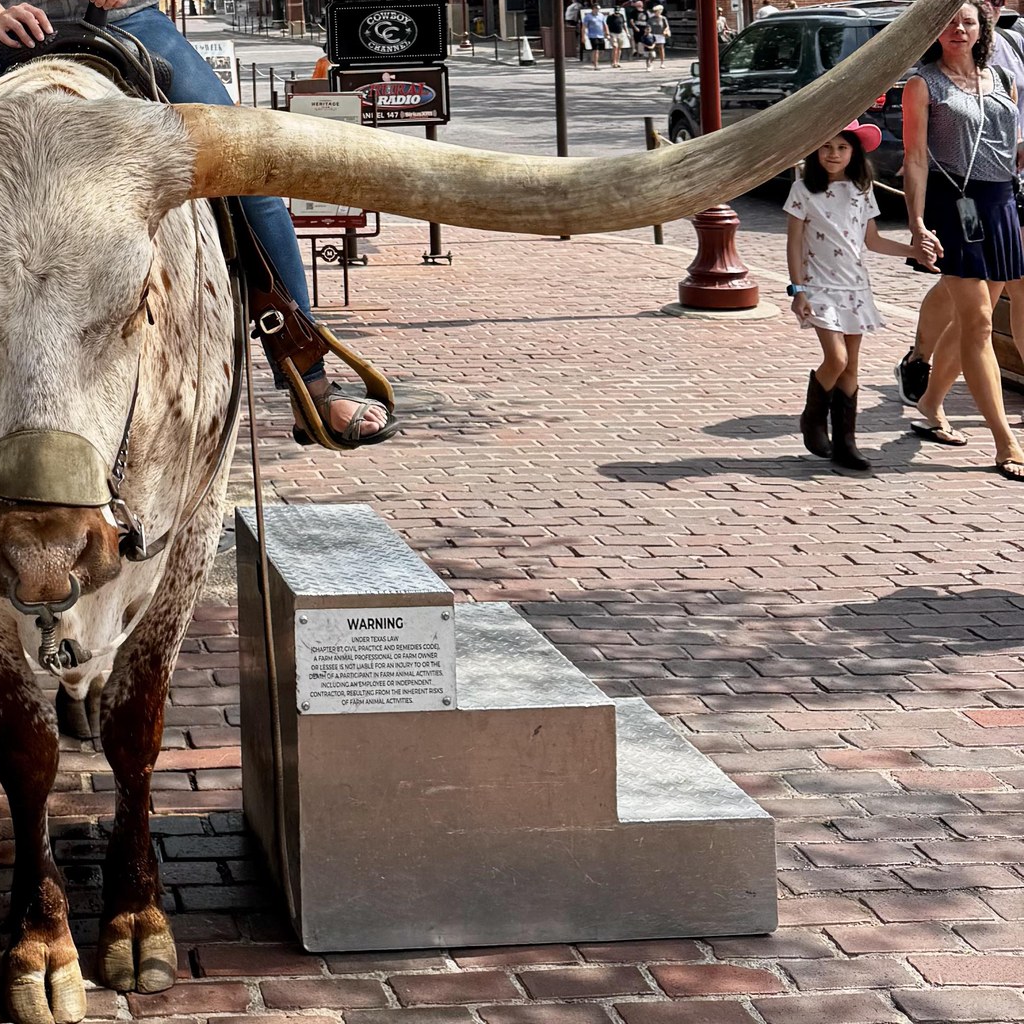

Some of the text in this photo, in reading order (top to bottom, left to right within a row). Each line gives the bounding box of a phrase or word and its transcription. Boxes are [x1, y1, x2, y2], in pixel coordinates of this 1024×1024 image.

[366, 12, 412, 25] COWBOY
[368, 41, 411, 52] CHANNEL
[377, 94, 421, 105] RADIO
[347, 617, 403, 630] WARNING
